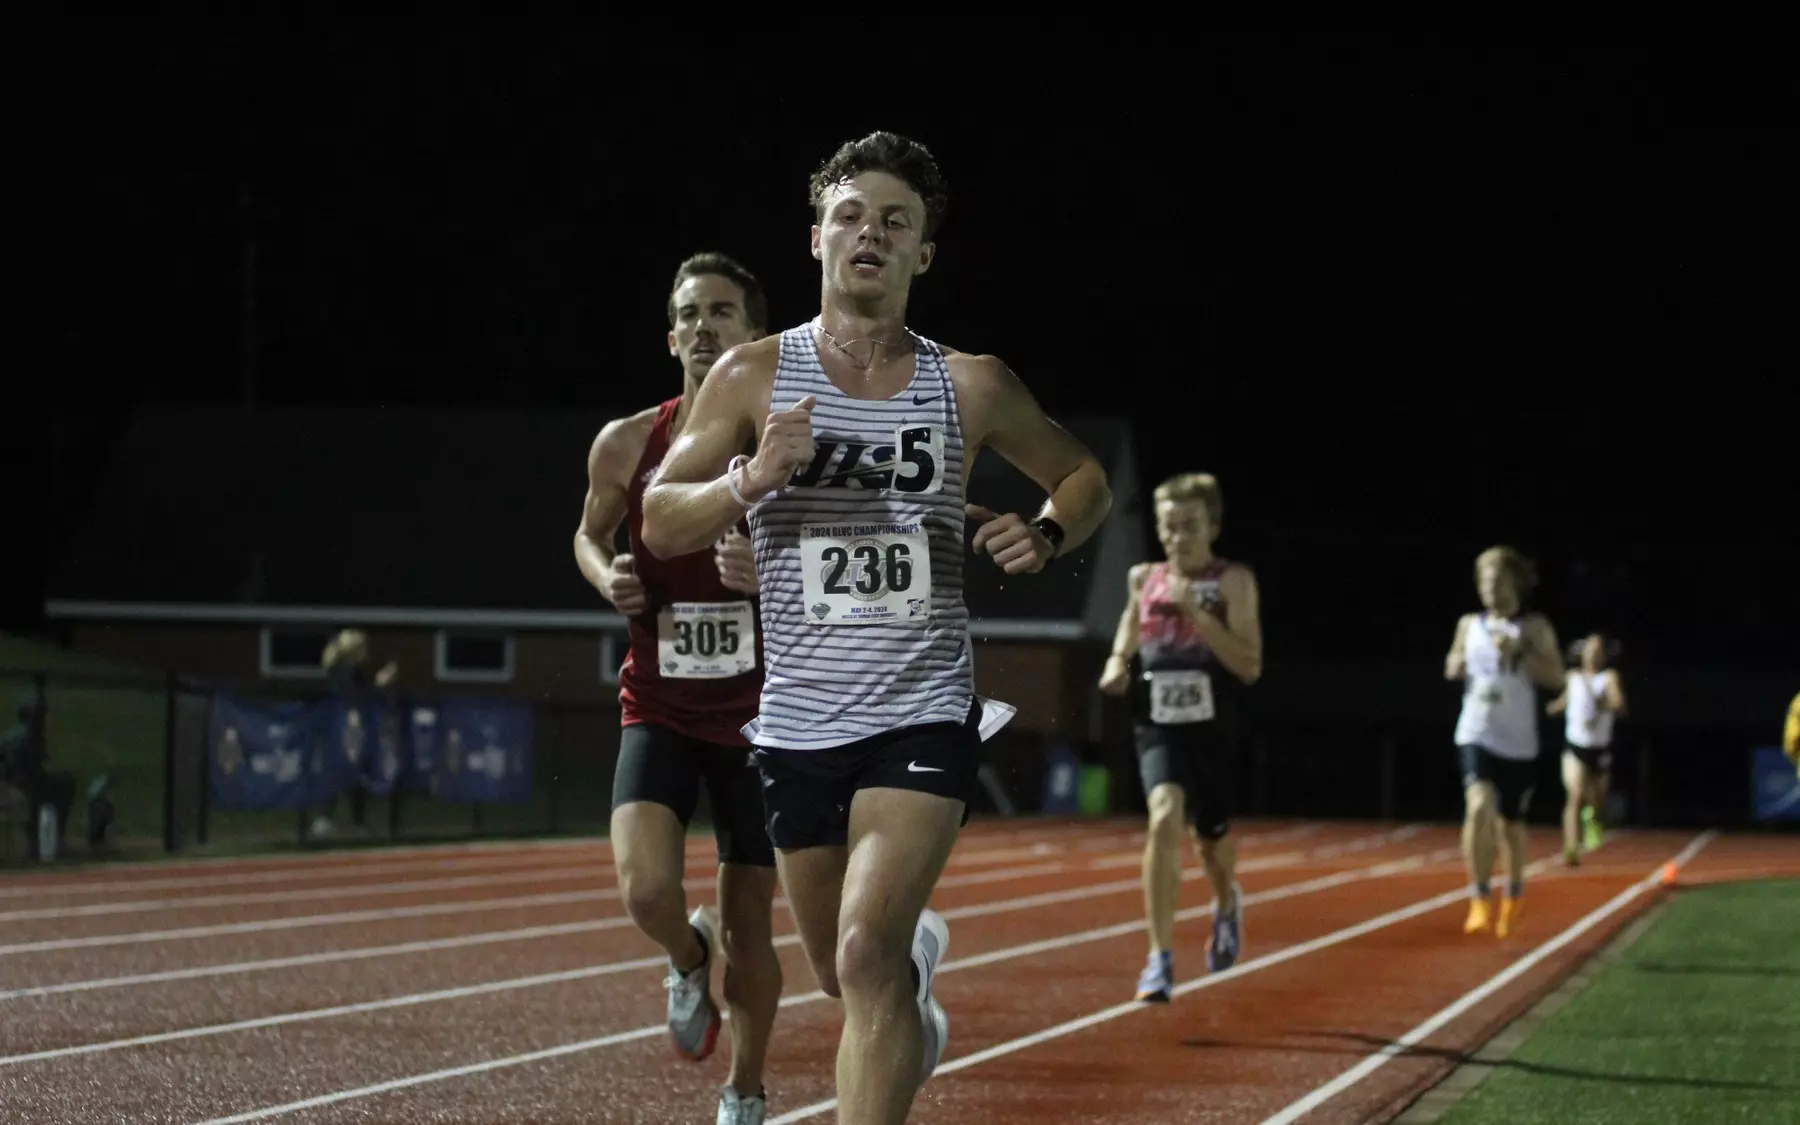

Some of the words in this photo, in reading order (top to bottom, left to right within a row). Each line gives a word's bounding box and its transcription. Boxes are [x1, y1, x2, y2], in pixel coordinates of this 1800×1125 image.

[894, 426, 936, 493] 5
[810, 526, 831, 538] 2024
[832, 526, 853, 537] GLVC
[854, 523, 919, 536] CHAMPIONSHIPS
[821, 543, 912, 595] 236
[673, 620, 739, 657] 305
